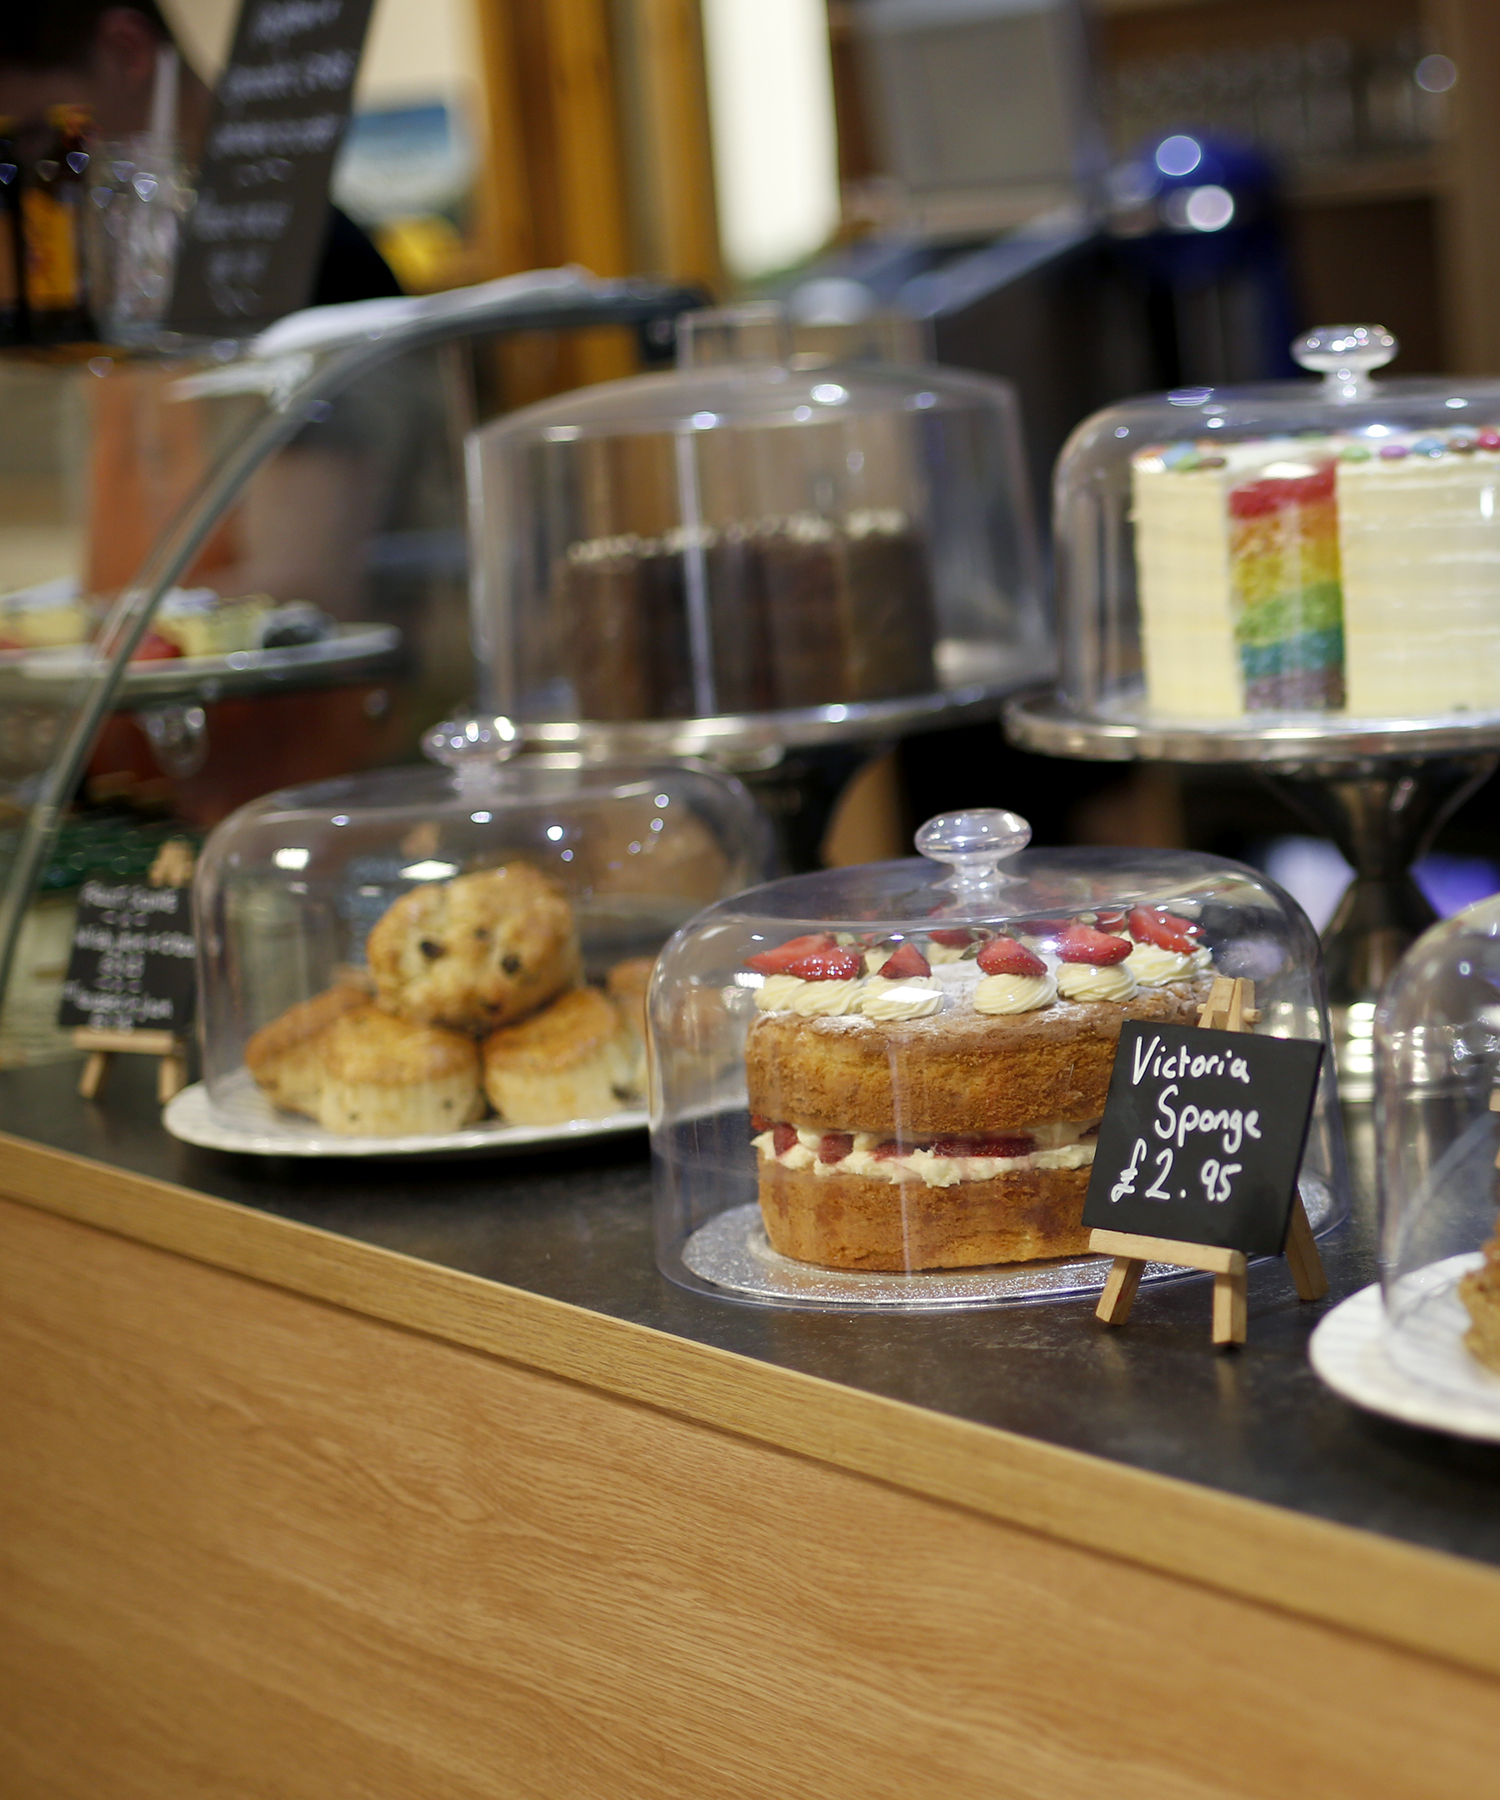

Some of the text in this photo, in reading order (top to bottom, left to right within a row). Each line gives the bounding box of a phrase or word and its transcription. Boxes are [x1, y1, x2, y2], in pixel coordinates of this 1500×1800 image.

[1132, 1035, 1250, 1085] Victoria
[1154, 1084, 1262, 1154] Sponge
[1110, 1138, 1243, 1203] £2.95
